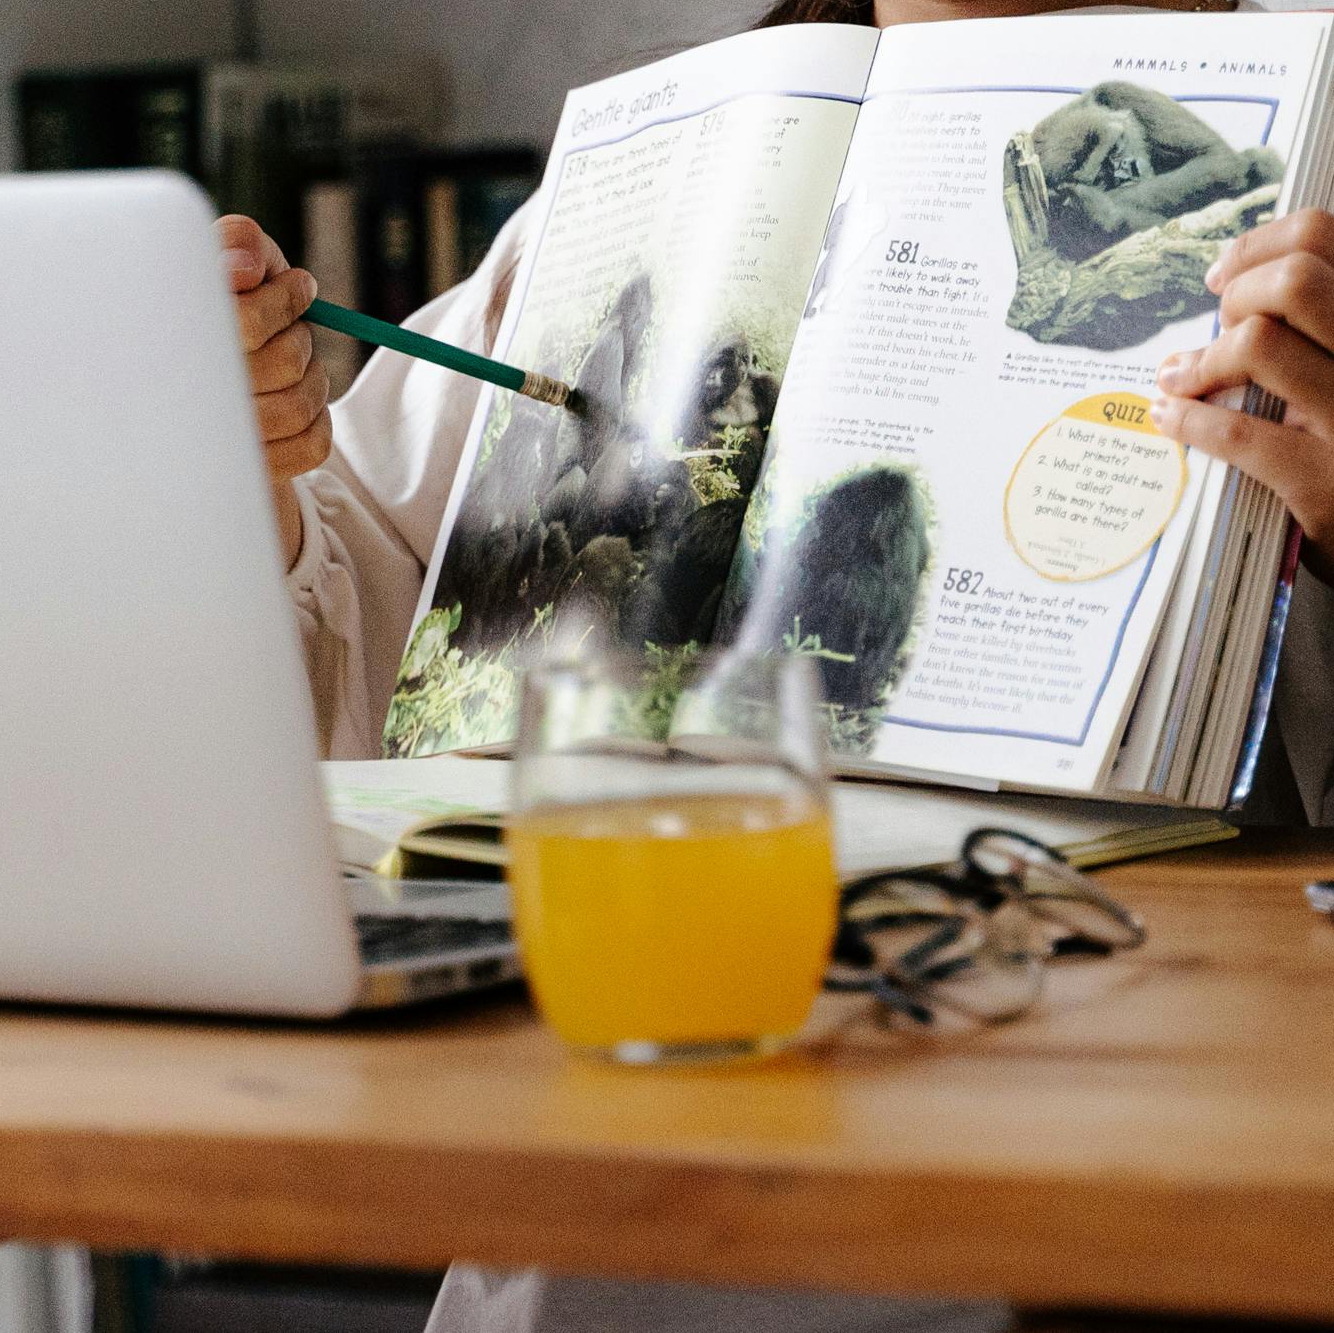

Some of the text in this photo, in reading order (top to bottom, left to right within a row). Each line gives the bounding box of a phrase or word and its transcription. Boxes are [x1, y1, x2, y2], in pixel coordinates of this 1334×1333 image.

[1113, 58, 1287, 76] MAMMALS ANIMALS
[571, 79, 678, 138] Gentle giants
[948, 111, 982, 124] gorillas
[783, 116, 800, 125] are
[940, 126, 981, 136] nests to
[775, 127, 787, 138] of
[942, 153, 965, 164] break
[967, 155, 986, 165] and
[963, 170, 987, 181] good
[938, 182, 961, 196] They
[962, 186, 986, 195] never
[933, 197, 947, 207] the
[949, 201, 973, 210] same
[750, 228, 771, 242] keep
[886, 239, 978, 271] 581 Gorillas are
[886, 266, 980, 288] likely to walk away
[878, 281, 913, 295] trouble
[918, 285, 939, 298] than
[902, 301, 934, 313] escape
[935, 305, 948, 314] an
[887, 313, 909, 325] male
[912, 317, 937, 328] stares
[940, 320, 954, 329] at
[955, 320, 968, 331] the
[877, 326, 894, 338] this
[896, 328, 929, 342] doesn't
[931, 333, 957, 346] work,
[959, 336, 971, 347] he
[872, 341, 977, 363] and beats his chest. He
[851, 354, 956, 376] intruder as a last resort
[858, 369, 881, 383] huge
[883, 371, 907, 386] fangs
[909, 376, 930, 387] and
[862, 385, 873, 396] to
[874, 385, 891, 398] kill
[892, 388, 905, 400] his
[1102, 401, 1147, 424] QUIZ
[1068, 427, 1095, 443] What
[1098, 435, 1107, 447] is
[1111, 437, 1128, 452] the
[1131, 442, 1169, 461] largest
[1082, 451, 1130, 467] primate?
[1053, 456, 1080, 473] What
[1083, 465, 1092, 476] is
[1095, 469, 1108, 481] an
[1111, 471, 1140, 485] adult
[1141, 479, 1163, 493] male
[1075, 481, 1114, 496] called?
[1047, 487, 1068, 502] How
[1070, 496, 1096, 511] many
[1099, 500, 1128, 518] types
[1131, 507, 1145, 521] of
[1035, 504, 1130, 533] gorilla are there?
[943, 567, 1109, 616] 582 About two out of every
[940, 594, 1089, 629] five gorillas die before they
[937, 612, 967, 626] reach
[971, 615, 997, 630] their
[1001, 619, 1027, 635] first
[934, 627, 1077, 657] Some are killed by silverbacks
[927, 641, 951, 656] from
[953, 647, 979, 660] other
[981, 651, 1020, 667] families,
[1022, 656, 1039, 668] but
[922, 658, 947, 672] don't
[949, 660, 975, 676] know
[979, 665, 995, 678] the
[997, 671, 1028, 684] reason
[1030, 673, 1045, 686] for
[1047, 678, 1071, 690] most
[914, 671, 1075, 706] the deaths. It's most likely that the
[905, 687, 936, 702] babies
[938, 693, 970, 710] simply
[972, 697, 1008, 712] become
